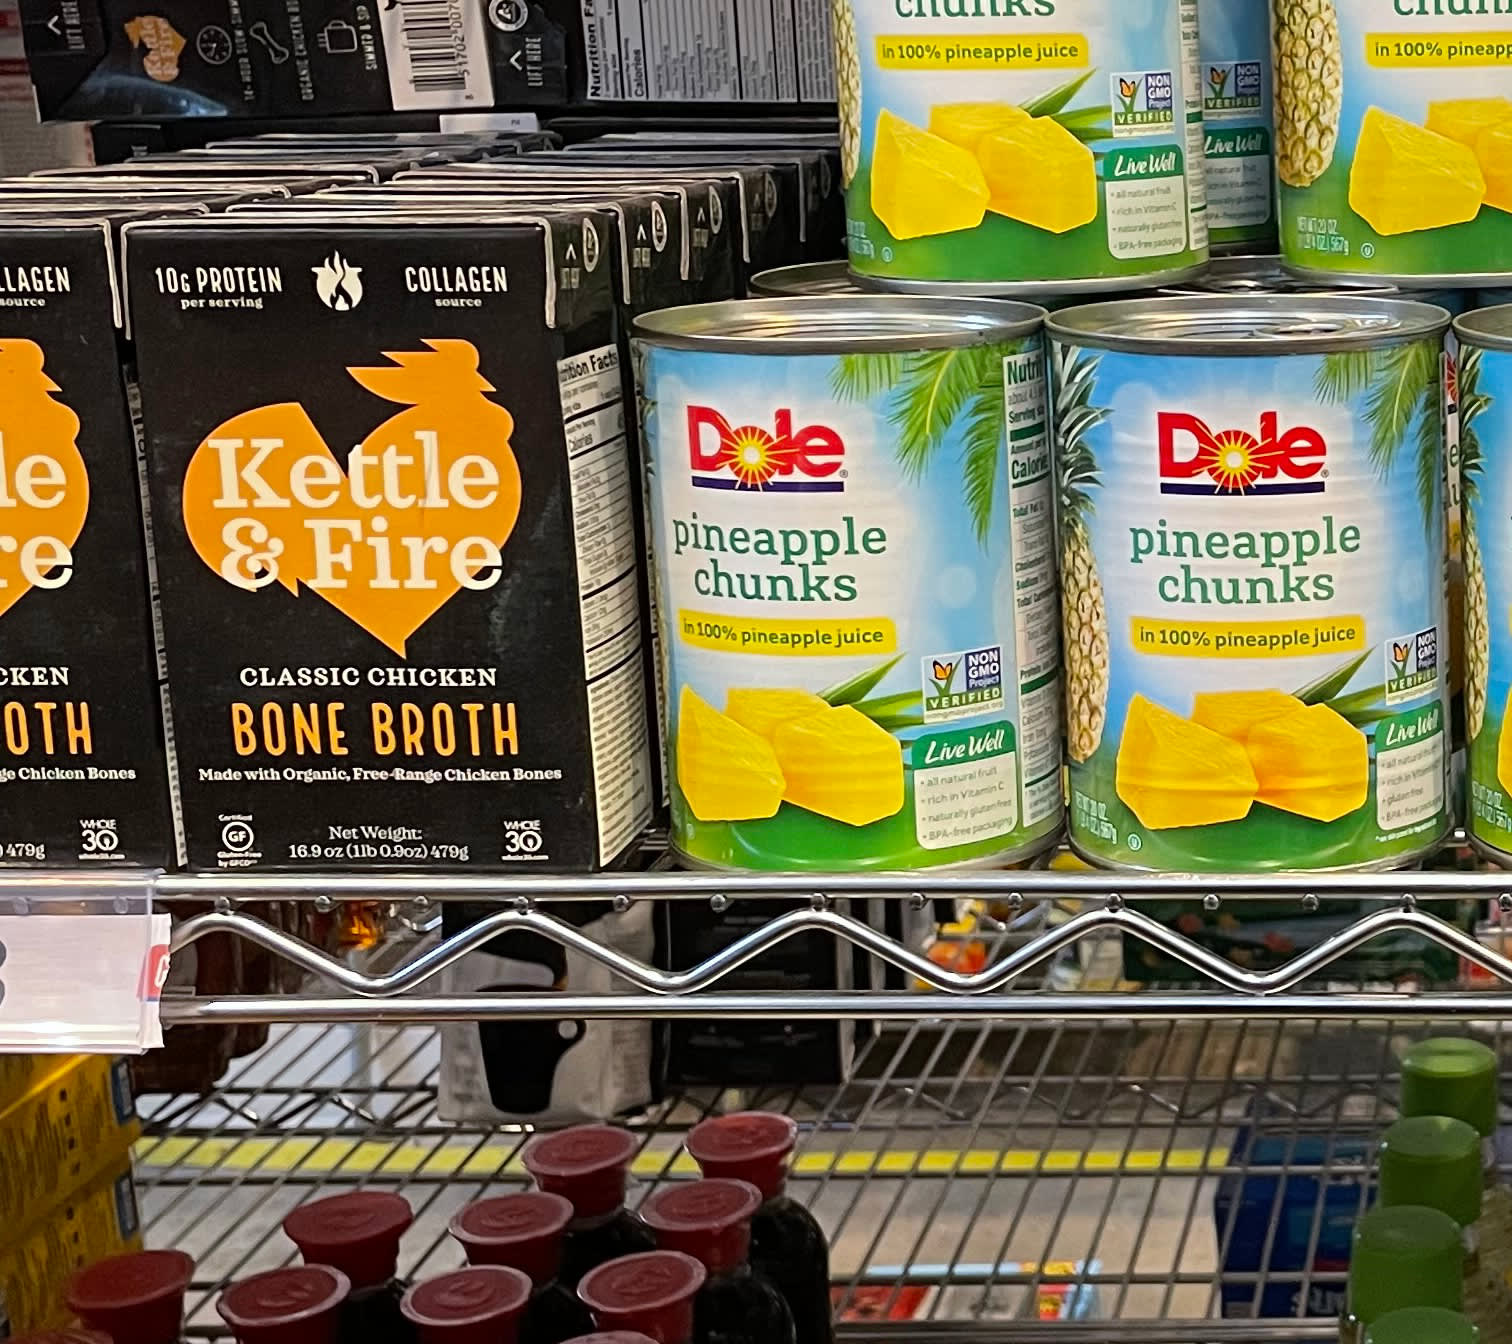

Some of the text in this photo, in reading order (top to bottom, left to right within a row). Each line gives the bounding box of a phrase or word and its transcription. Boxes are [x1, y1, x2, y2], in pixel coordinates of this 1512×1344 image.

[586, 24, 601, 97] Nutrition
[881, 43, 1079, 63] in 100% pineapple juice
[632, 49, 644, 97] Calories
[196, 266, 283, 294] PROTEIN
[404, 265, 508, 294] COLLAGEN
[180, 296, 264, 311] per serving
[434, 297, 483, 308] source
[686, 404, 846, 486] Dole
[1156, 410, 1328, 489] Dole
[206, 430, 500, 510] Kettle
[220, 515, 504, 592] & Fire
[672, 512, 888, 566] pineapple
[1129, 514, 1362, 568] pineapple
[694, 558, 858, 602] chunks
[1157, 564, 1335, 604] chunks
[968, 650, 998, 666] NON
[968, 662, 1000, 677] GMO
[239, 667, 497, 687] CLASSIC CHICKEN
[968, 676, 999, 689] Project
[928, 687, 1001, 711] VERIFIED
[231, 701, 520, 757] BONE BROTH
[924, 728, 1006, 763] Live Well
[198, 767, 563, 783] Made with Organic, Free-Range Chicken Bones
[328, 825, 423, 842] Net Weight:
[288, 843, 469, 861] 16.9 oz (1lb 0.9oz) 479g
